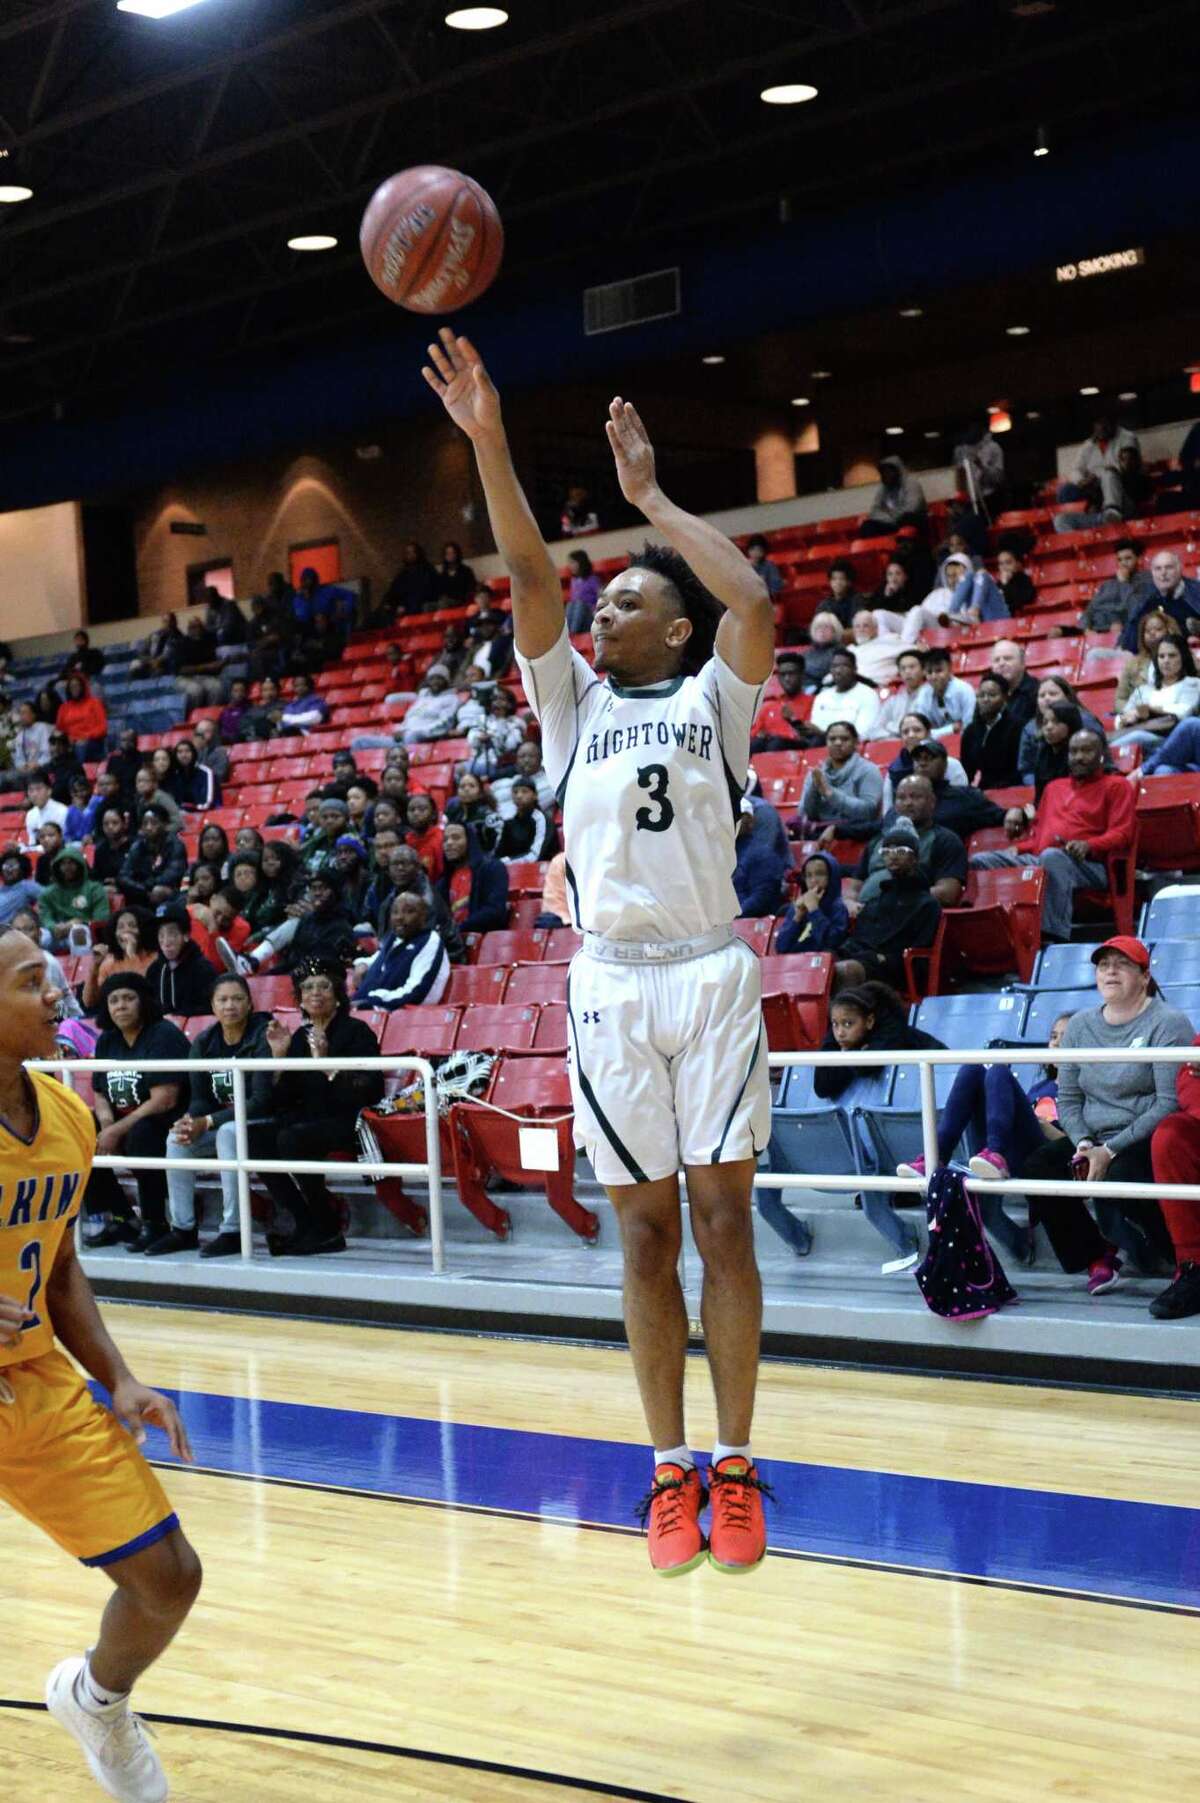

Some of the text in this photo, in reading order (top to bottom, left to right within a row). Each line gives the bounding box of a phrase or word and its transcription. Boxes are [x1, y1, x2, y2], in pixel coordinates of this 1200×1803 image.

[1056, 249, 1138, 281] NO SMOKING
[586, 721, 713, 764] HIGHTOWER
[635, 763, 675, 832] 3
[0, 1172, 80, 1227] KIN
